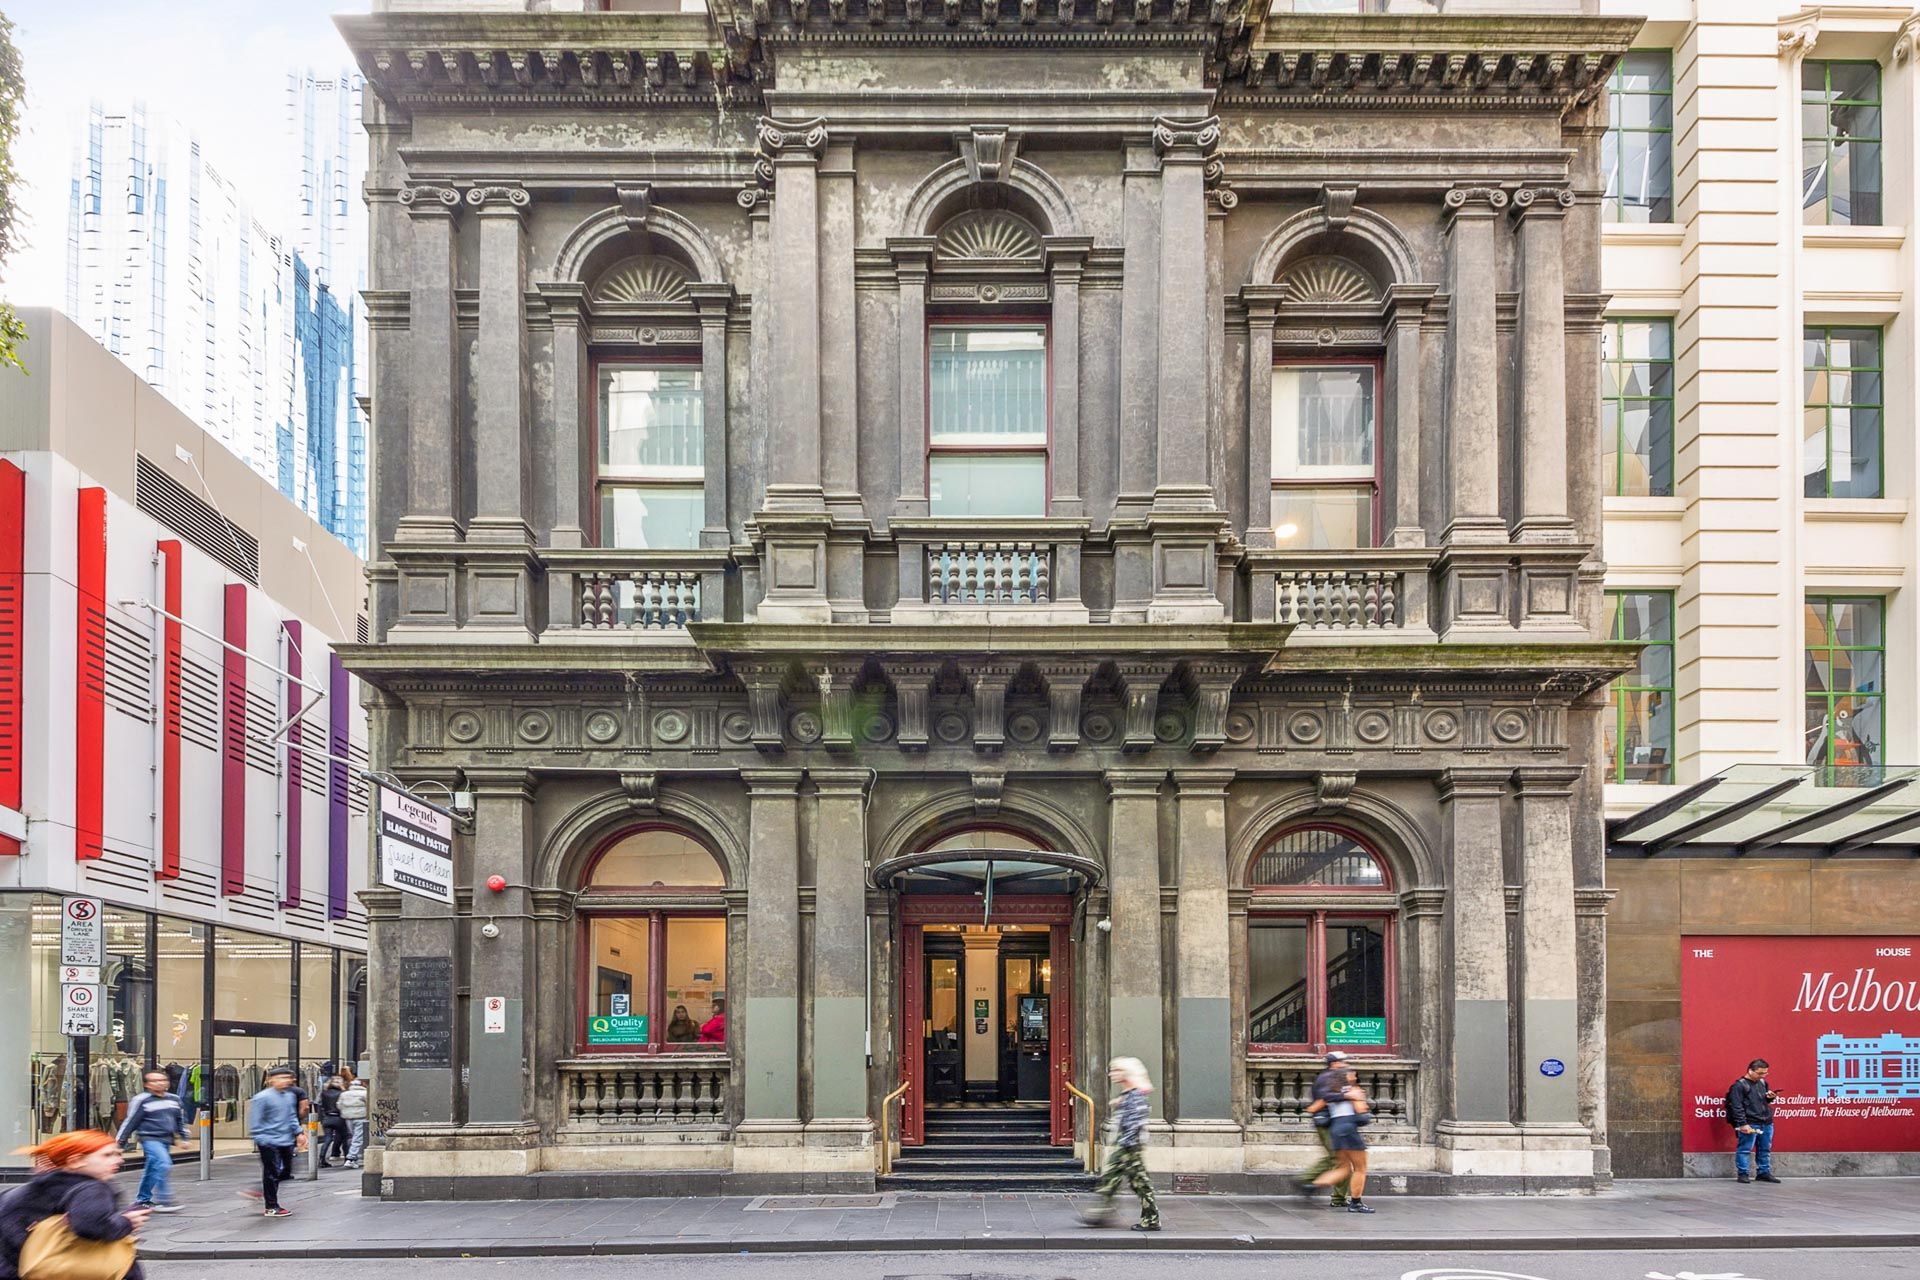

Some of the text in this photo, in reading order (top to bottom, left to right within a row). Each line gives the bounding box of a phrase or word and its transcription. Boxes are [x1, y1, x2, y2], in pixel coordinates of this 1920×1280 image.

[398, 796, 437, 824] Legends
[386, 820, 449, 854] BLACK STAR PASTRY
[388, 845, 414, 865] Sweet
[1876, 948, 1911, 956] HOUSE
[76, 992, 86, 1000] 10
[1792, 968, 1920, 1012] Melbou
[593, 1018, 610, 1032] Q
[611, 1018, 643, 1028] Quality
[1330, 1020, 1347, 1033] Q
[1348, 1020, 1380, 1030] Quality
[1694, 1096, 1726, 1104] Wher
[1787, 1094, 1814, 1104] culture
[1818, 1095, 1851, 1104] meets
[1852, 1095, 1900, 1106] community.
[1694, 1106, 1915, 1119] Set fo Emporium, The House of Melbourne.
